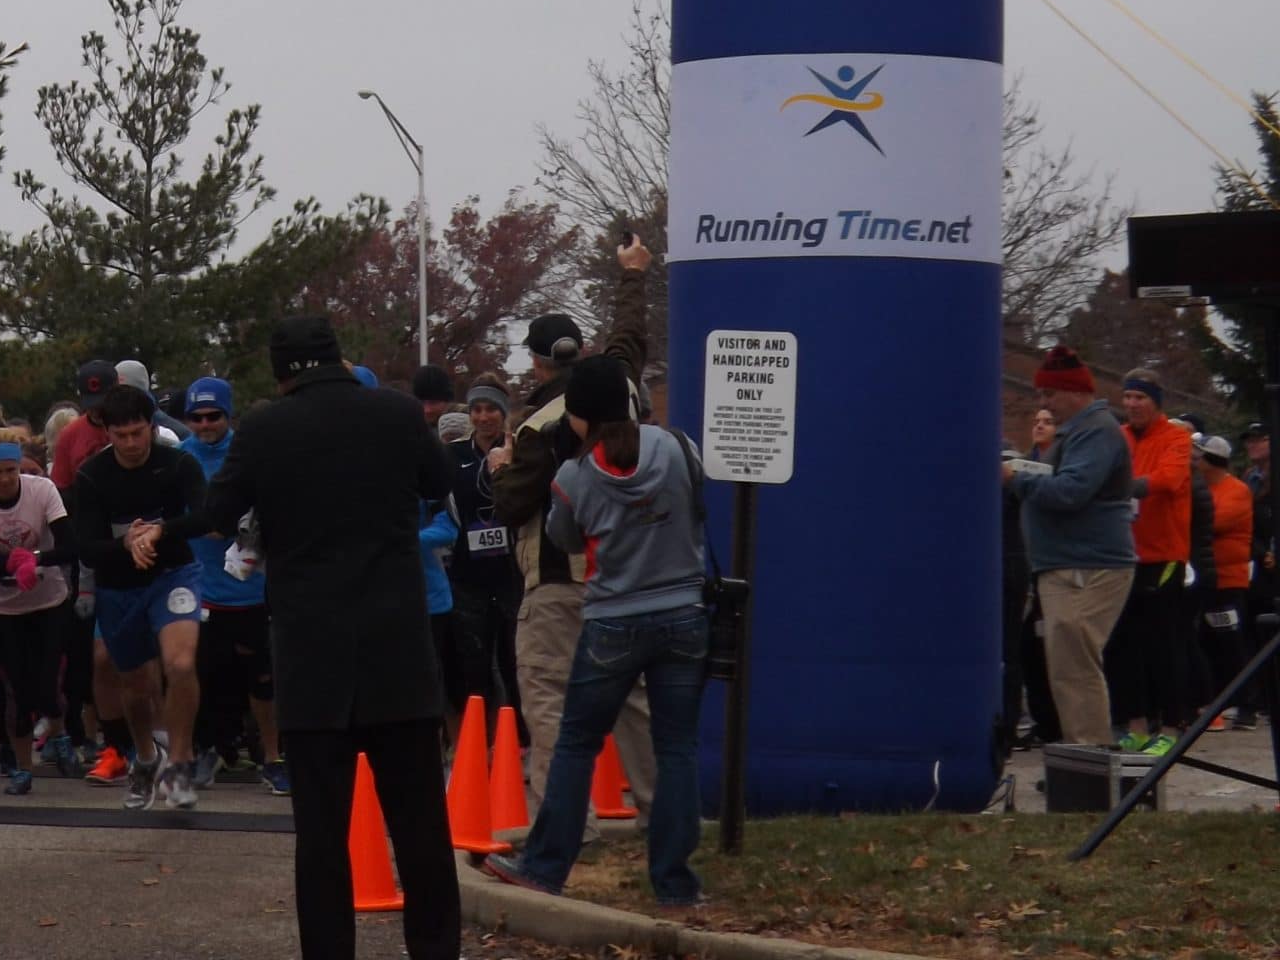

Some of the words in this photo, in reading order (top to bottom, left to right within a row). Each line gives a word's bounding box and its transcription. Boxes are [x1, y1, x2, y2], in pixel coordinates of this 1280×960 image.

[695, 212, 828, 247] Running
[837, 210, 973, 243] Time.net
[718, 338, 760, 350] VISITOR
[764, 339, 786, 351] AND
[713, 354, 790, 368] HANDICAPPED
[727, 372, 774, 384] PARKING
[737, 389, 763, 400] ONLY
[479, 529, 503, 546] 459
